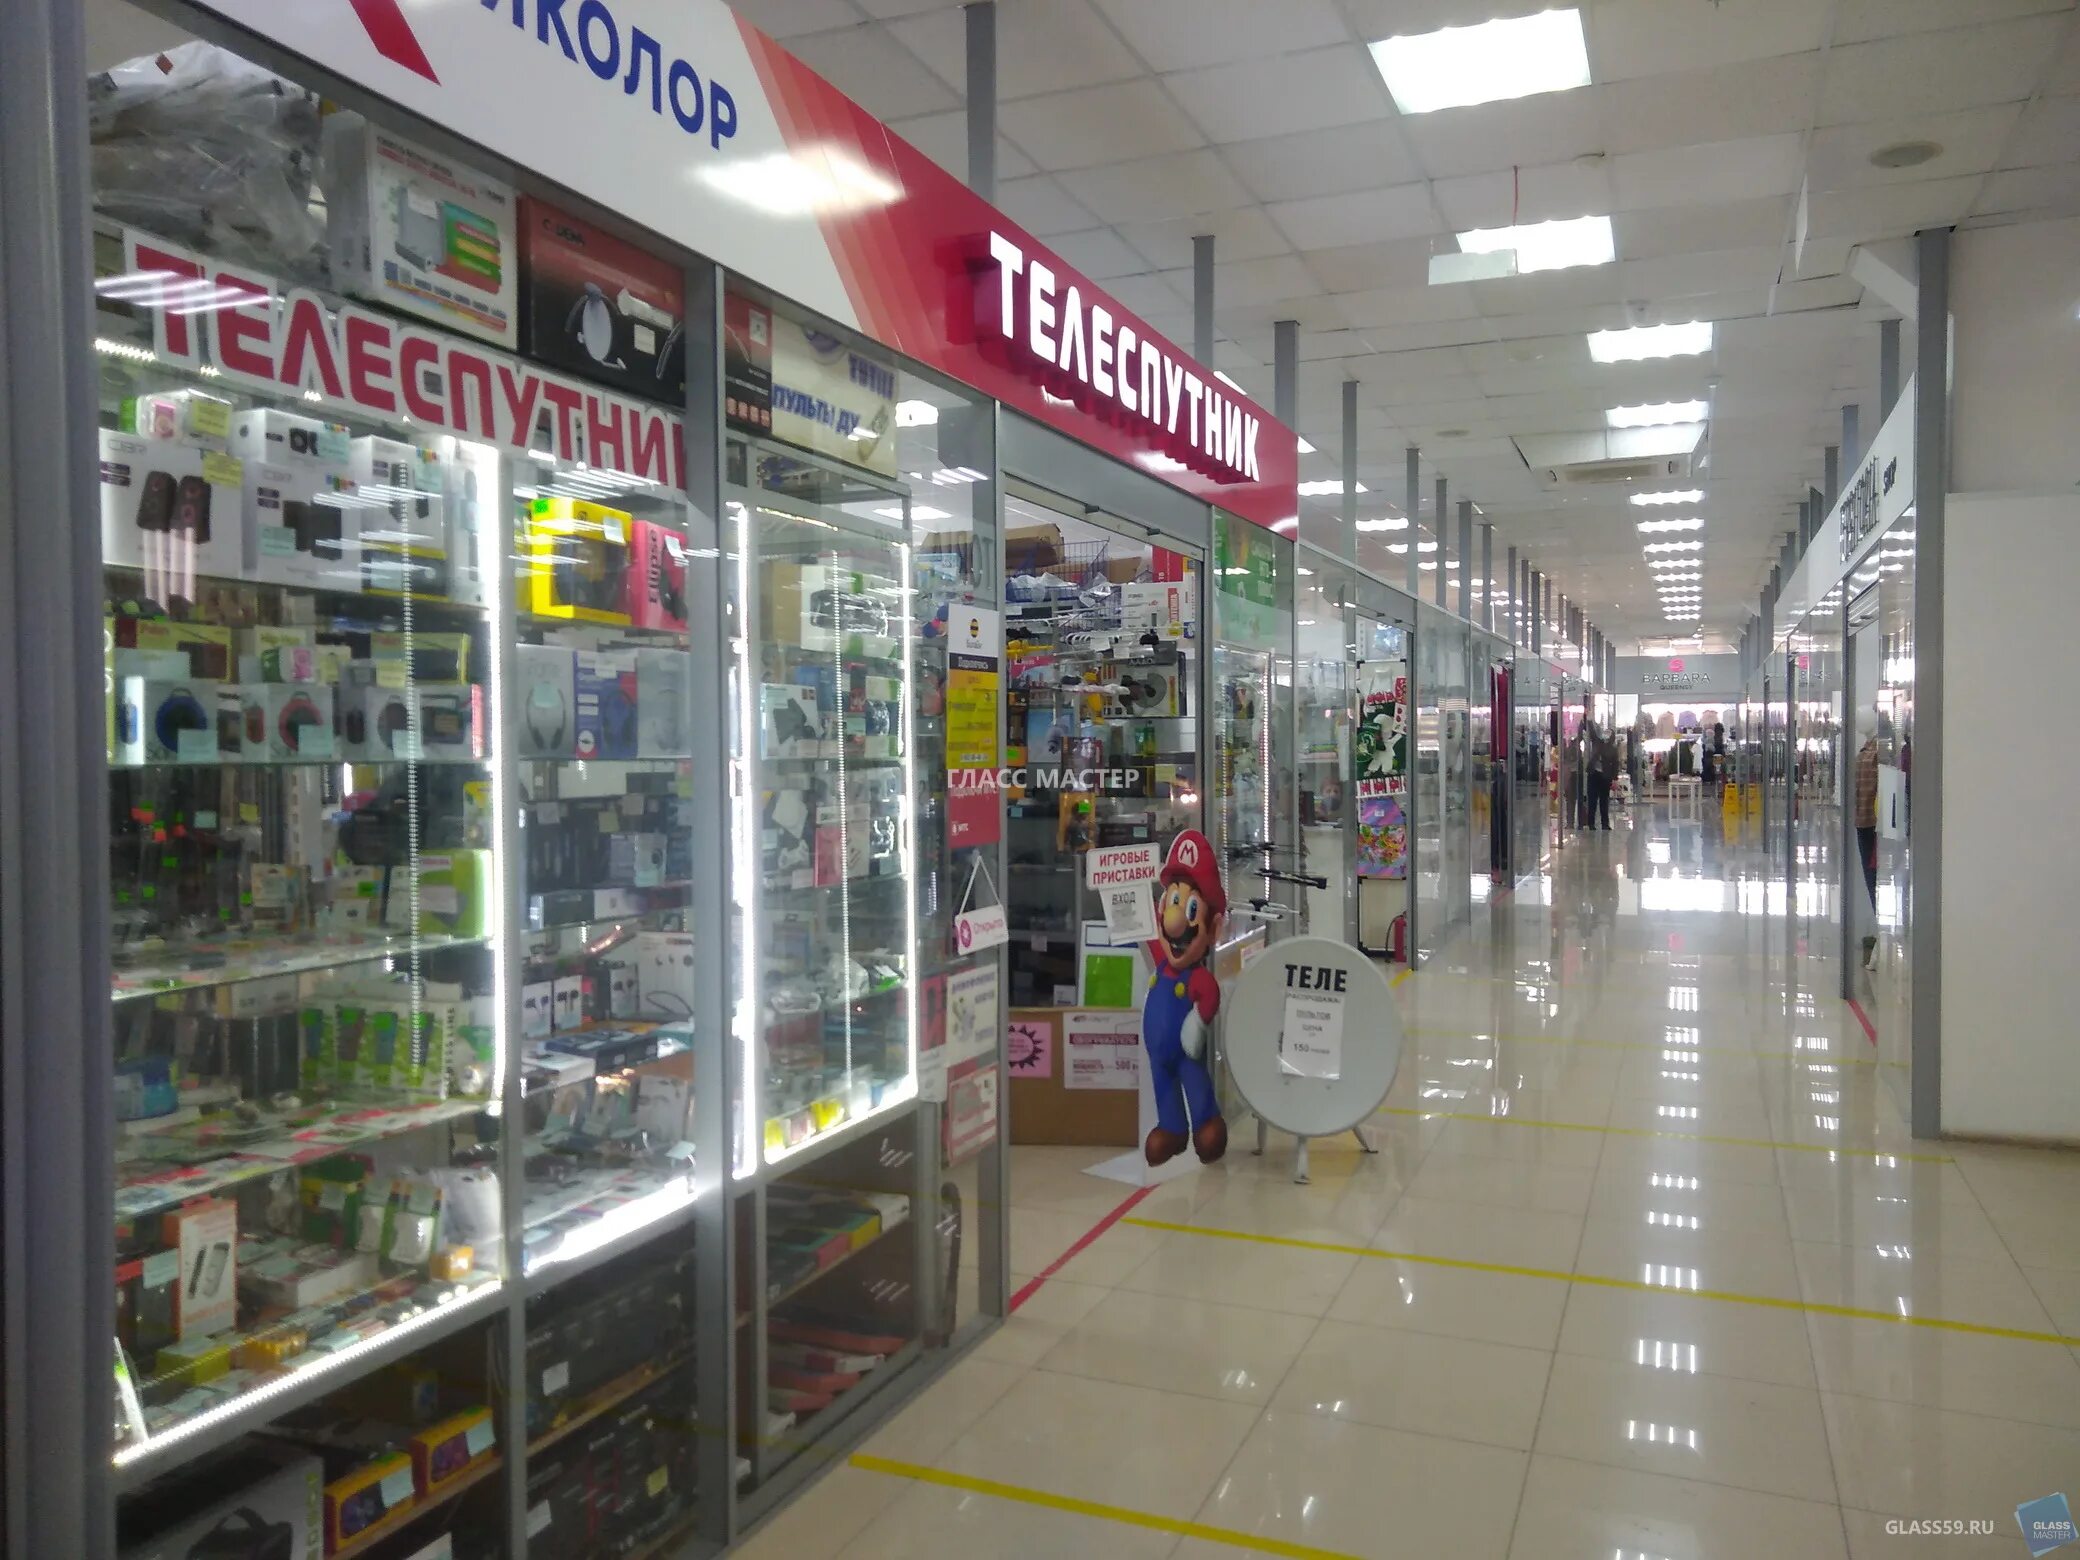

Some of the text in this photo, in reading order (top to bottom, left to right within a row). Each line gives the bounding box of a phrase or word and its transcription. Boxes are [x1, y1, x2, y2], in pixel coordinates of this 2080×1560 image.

[480, 0, 737, 150] КОЛОР
[990, 230, 1260, 482] ТЕЛЕСПУТНИК
[1642, 673, 1711, 683] BARBARA
[1099, 850, 1150, 867] ИГРОВЫЕ
[1092, 866, 1156, 885] ПРИСТАВКИ
[1111, 891, 1136, 906] ВХОД
[1284, 963, 1348, 993] ТЕЛЕ
